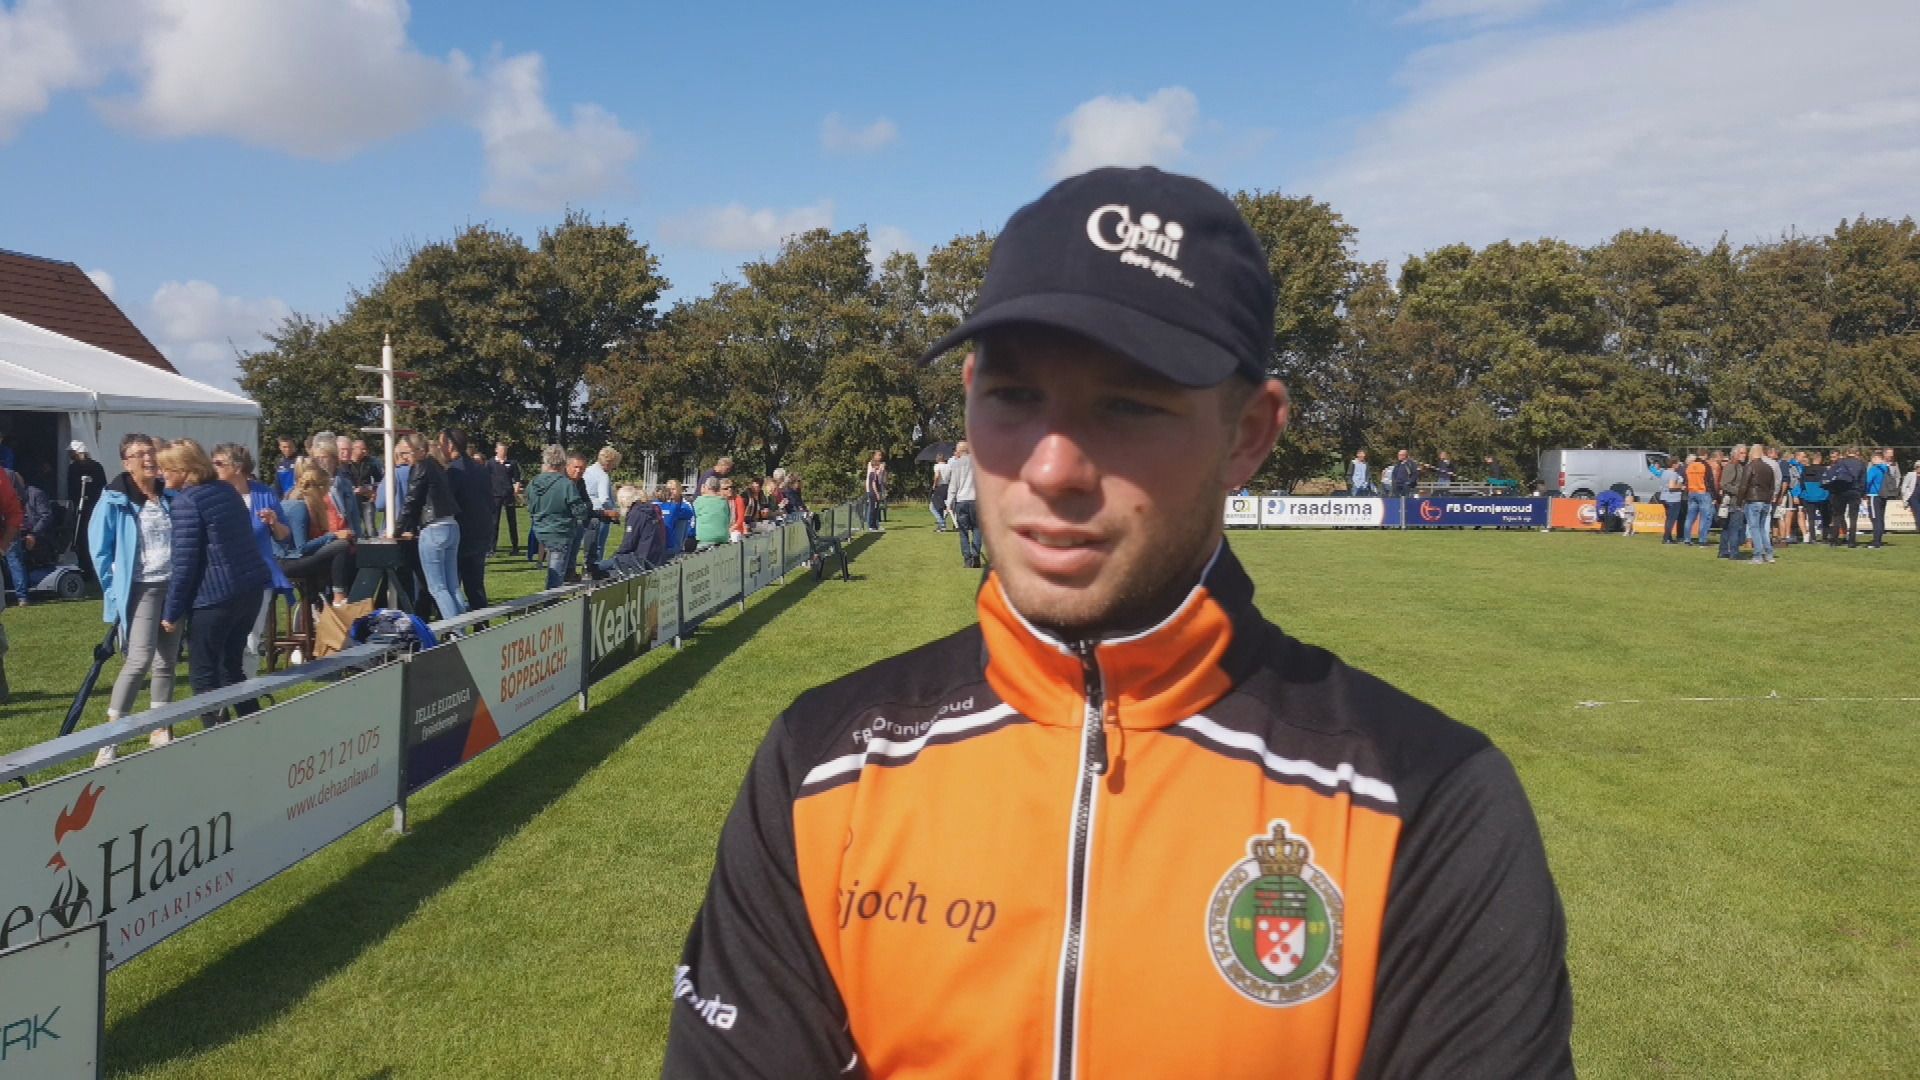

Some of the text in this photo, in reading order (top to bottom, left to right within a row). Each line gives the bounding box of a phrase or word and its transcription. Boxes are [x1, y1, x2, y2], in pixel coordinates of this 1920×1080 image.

[1086, 204, 1184, 260] Copini
[1290, 500, 1373, 515] raadsma
[1446, 503, 1533, 514] FB Oranjewoud
[501, 621, 564, 671] SITBAL OF IN
[286, 757, 380, 821] www.dehaanlaw.nl
[288, 725, 380, 789] 058 21 21 075
[98, 811, 234, 918] Haan
[120, 868, 236, 946] NOTARISSEN
[839, 879, 996, 943] joch op
